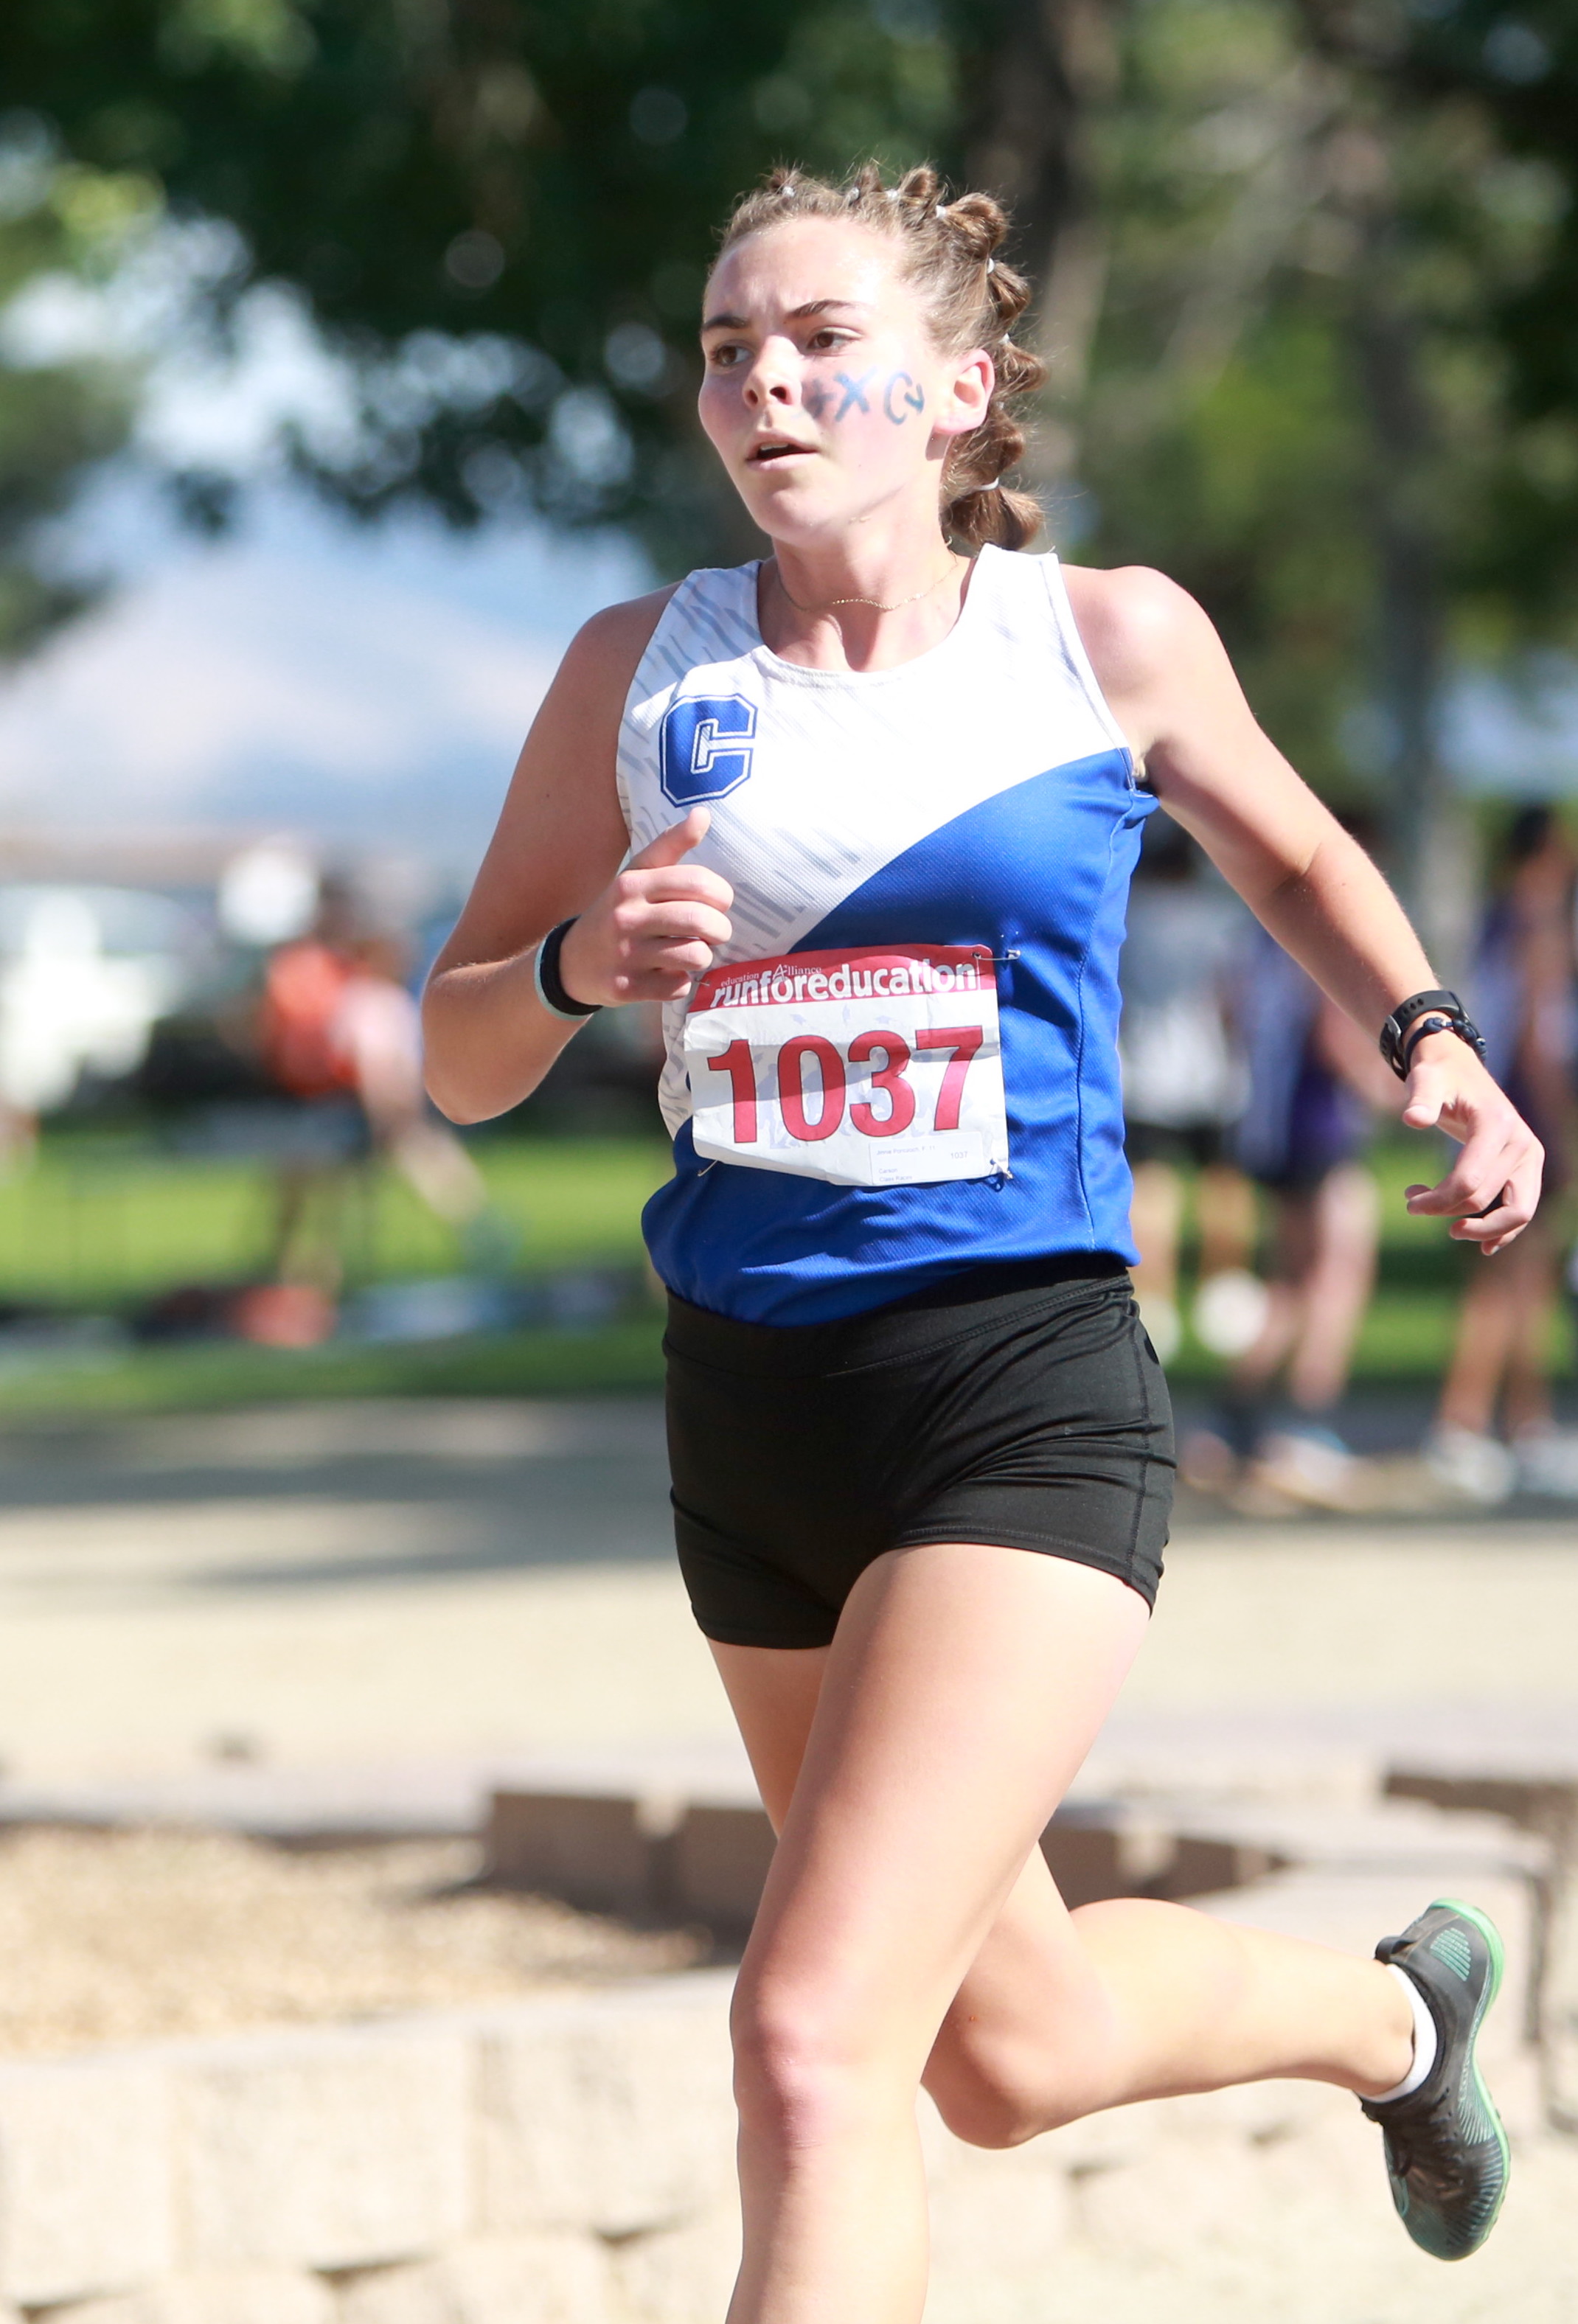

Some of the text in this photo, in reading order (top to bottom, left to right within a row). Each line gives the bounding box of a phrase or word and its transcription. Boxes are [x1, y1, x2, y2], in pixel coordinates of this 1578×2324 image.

[658, 693, 758, 807] C
[709, 958, 976, 1008] runforeducation
[720, 973, 760, 987] education
[707, 1026, 984, 1144] 1037
